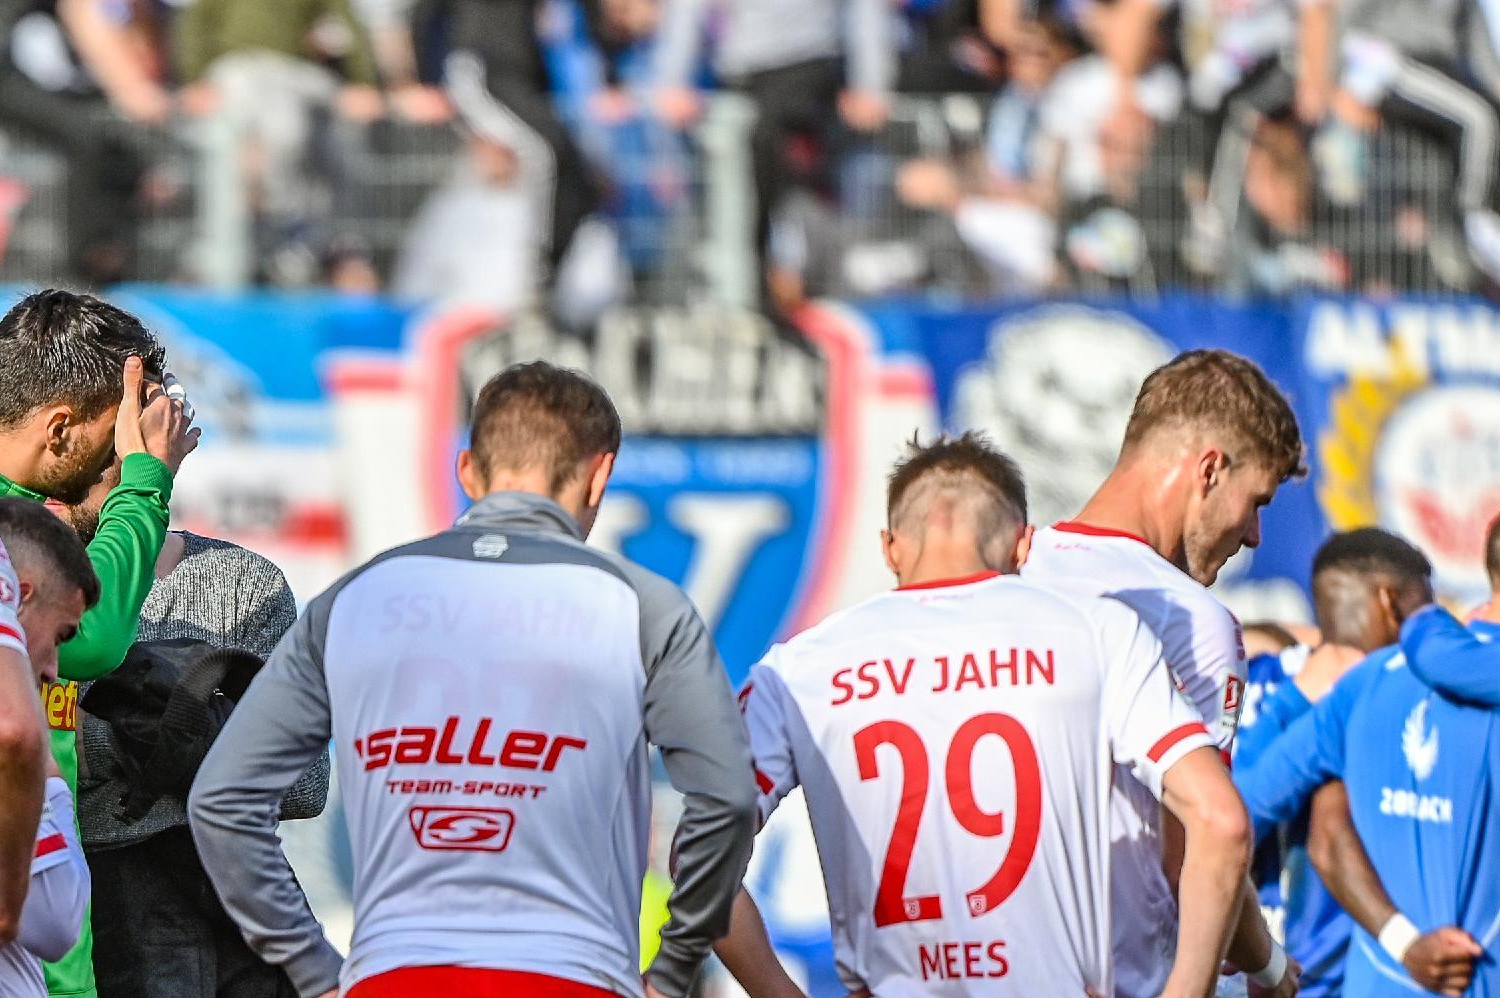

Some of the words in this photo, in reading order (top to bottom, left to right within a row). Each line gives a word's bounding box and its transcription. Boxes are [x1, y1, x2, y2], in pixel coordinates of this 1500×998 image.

[831, 657, 916, 706] SSV
[932, 647, 1056, 693] JAHN
[852, 711, 1043, 928] 29
[918, 938, 1010, 982] MEES
